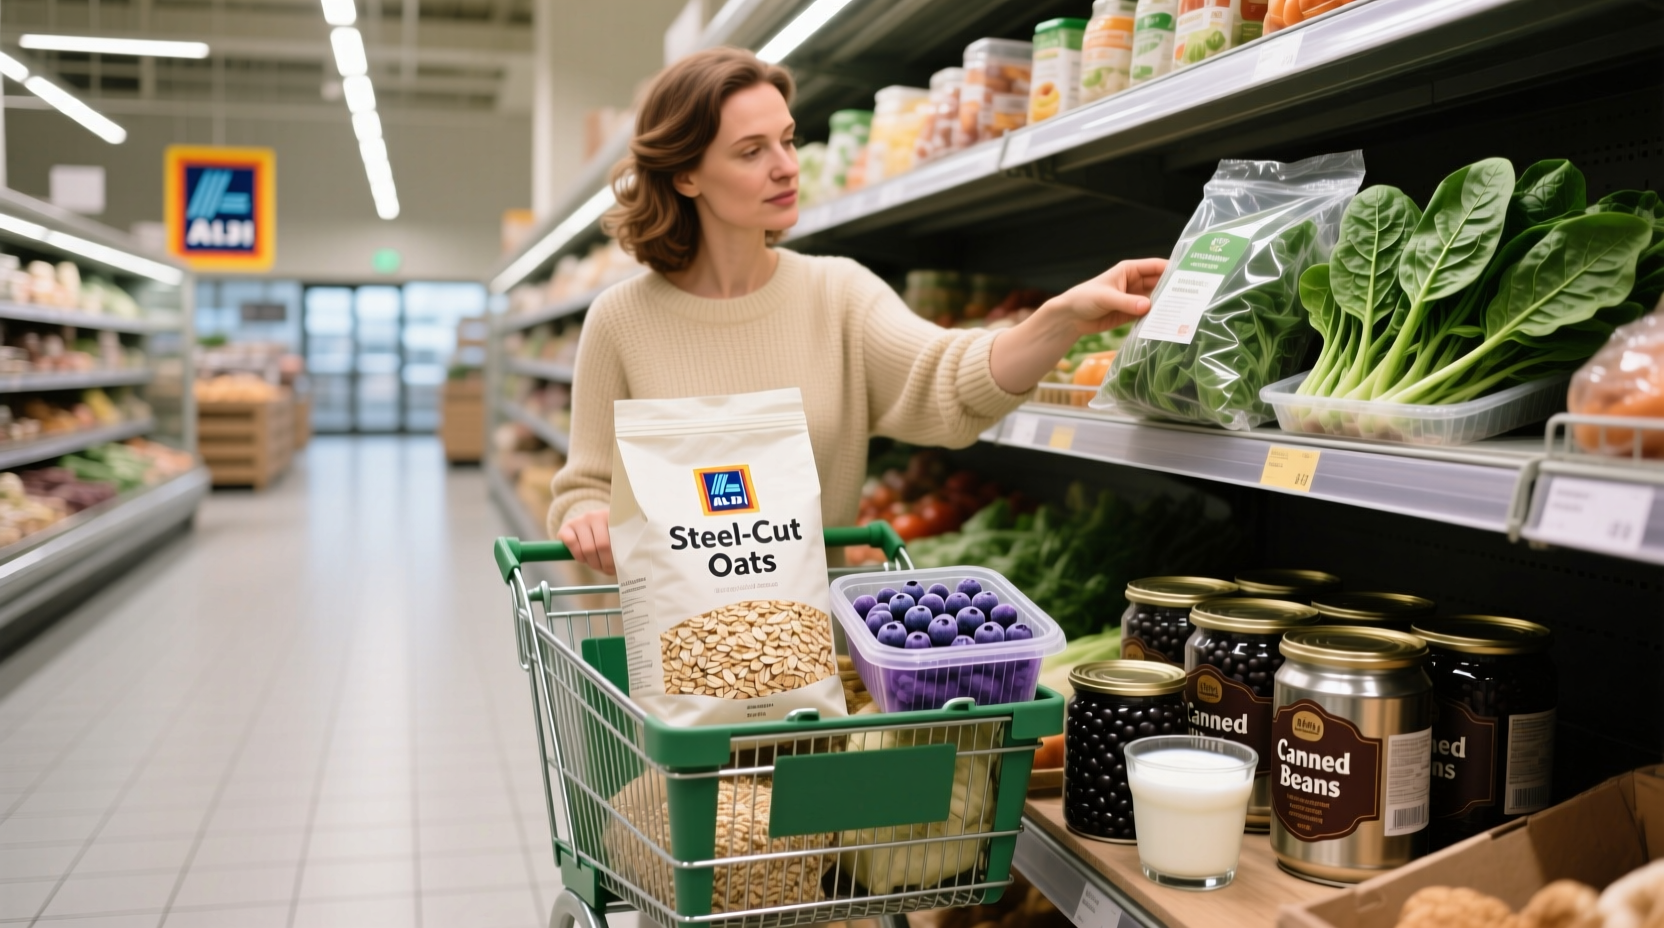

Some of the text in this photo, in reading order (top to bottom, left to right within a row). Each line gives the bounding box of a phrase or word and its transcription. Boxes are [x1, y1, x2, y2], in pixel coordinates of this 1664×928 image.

[669, 518, 803, 550] Steel-Cut
[708, 551, 777, 578] Oats
[1277, 738, 1350, 775] Canned
[1280, 764, 1341, 798] Beans
